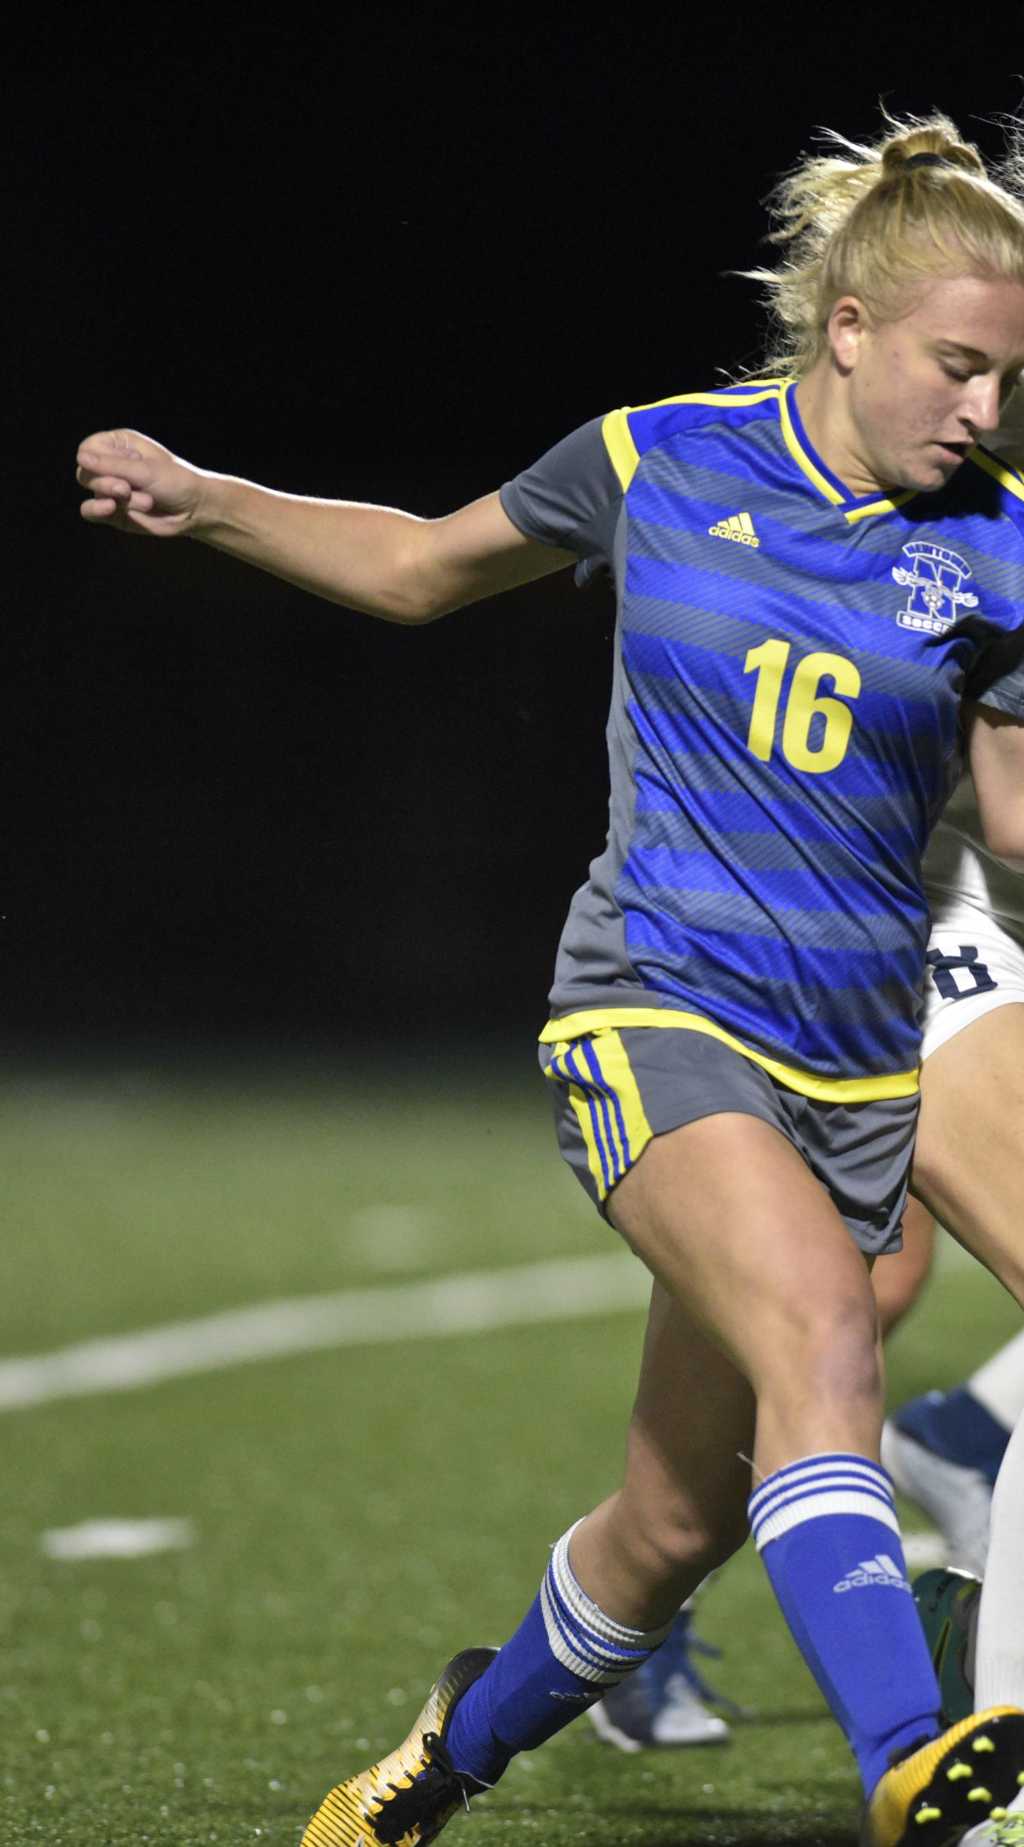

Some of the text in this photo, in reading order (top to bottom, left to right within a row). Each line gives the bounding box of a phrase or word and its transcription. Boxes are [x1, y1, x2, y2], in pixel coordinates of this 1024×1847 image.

[708, 526, 760, 548] adidas
[901, 614, 950, 634] SOCCE
[743, 639, 862, 774] 16
